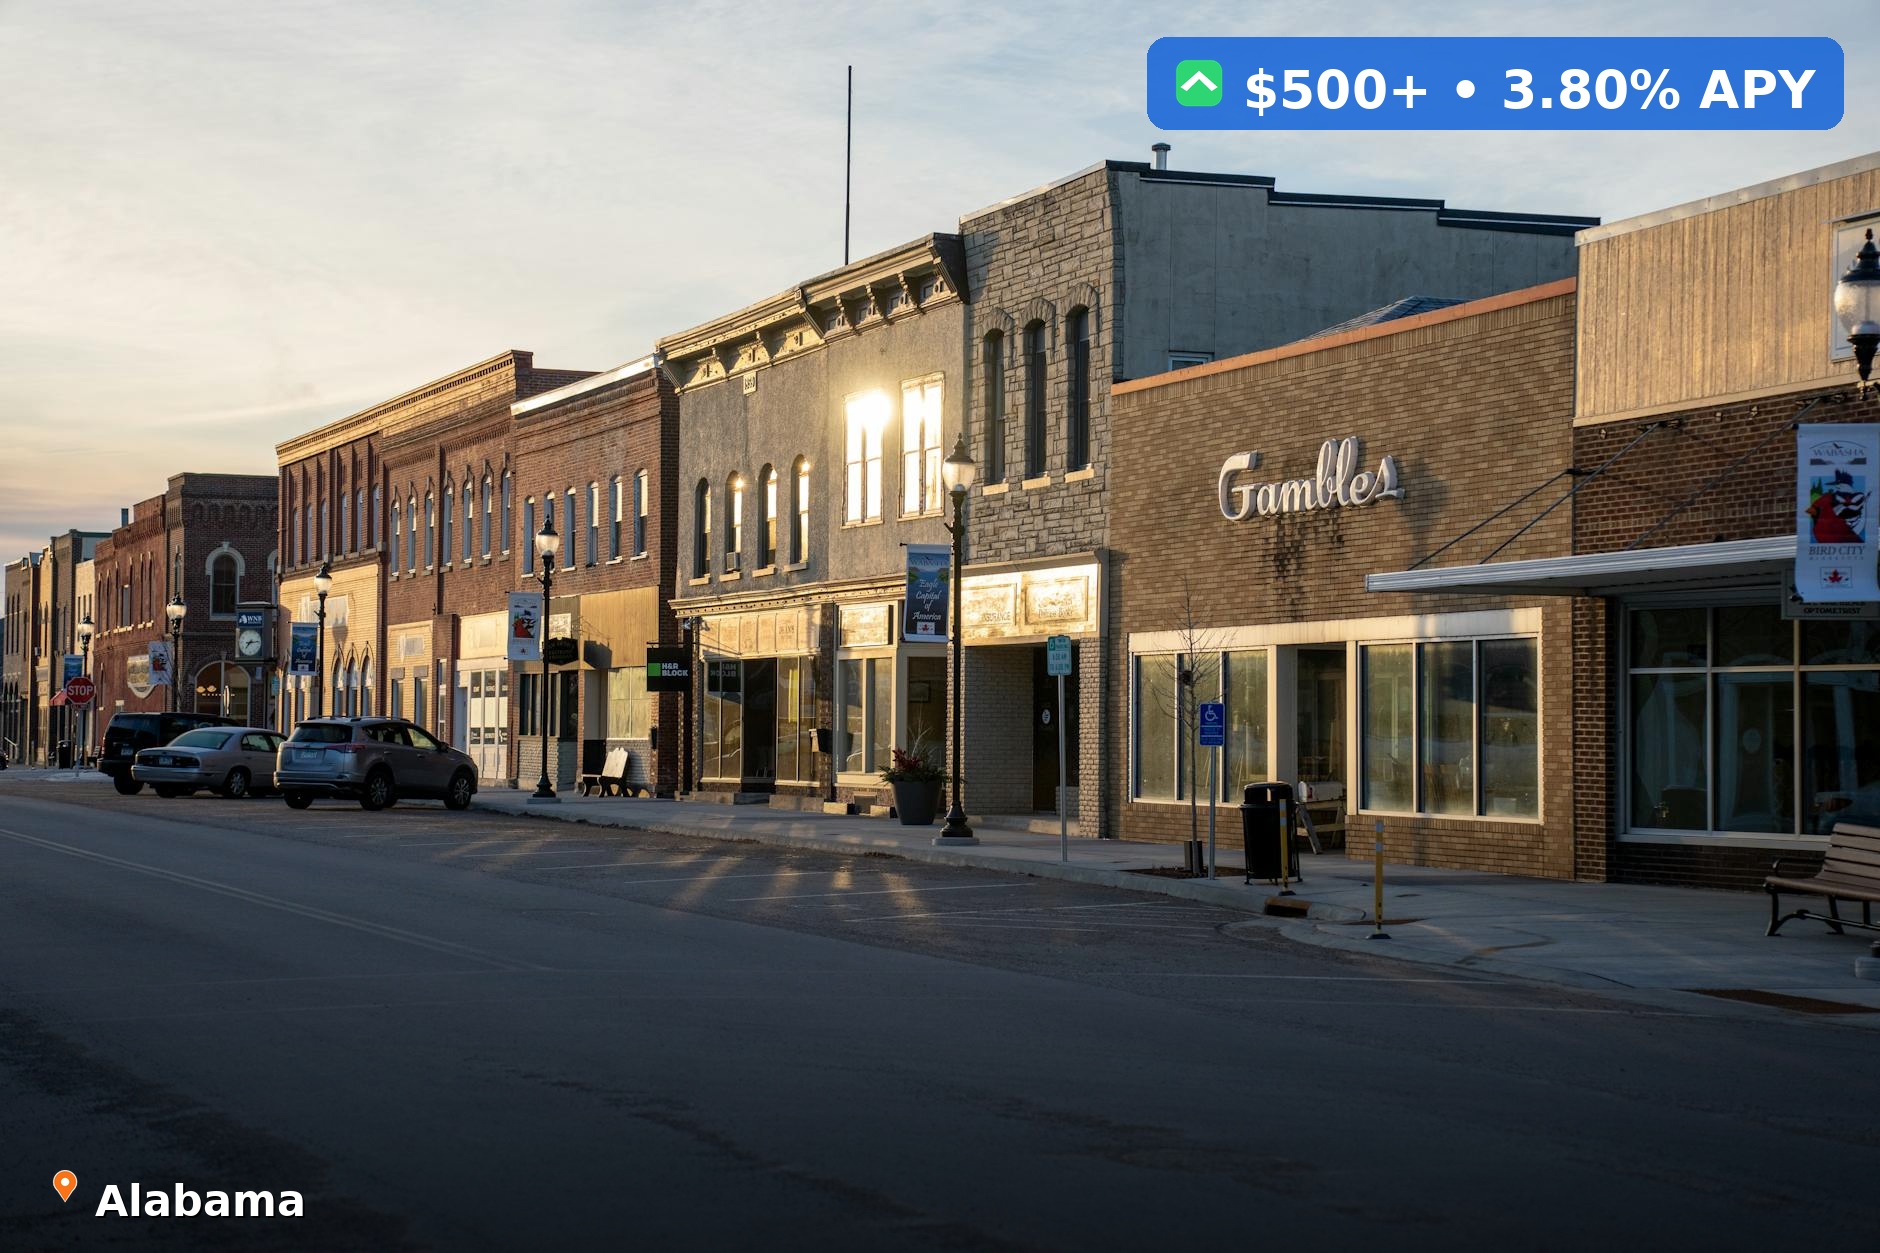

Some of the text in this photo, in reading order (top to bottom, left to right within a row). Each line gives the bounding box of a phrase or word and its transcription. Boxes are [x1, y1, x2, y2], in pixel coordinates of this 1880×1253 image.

[1812, 447, 1865, 457] WABASHA
[1218, 435, 1406, 522] Gambles
[1808, 545, 1866, 556] BIRD CITY
[915, 590, 943, 604] Capital
[924, 601, 934, 612] of
[912, 611, 942, 621] America
[661, 662, 679, 670] H&R
[661, 669, 689, 677] BLOCK
[68, 685, 94, 696] STOP
